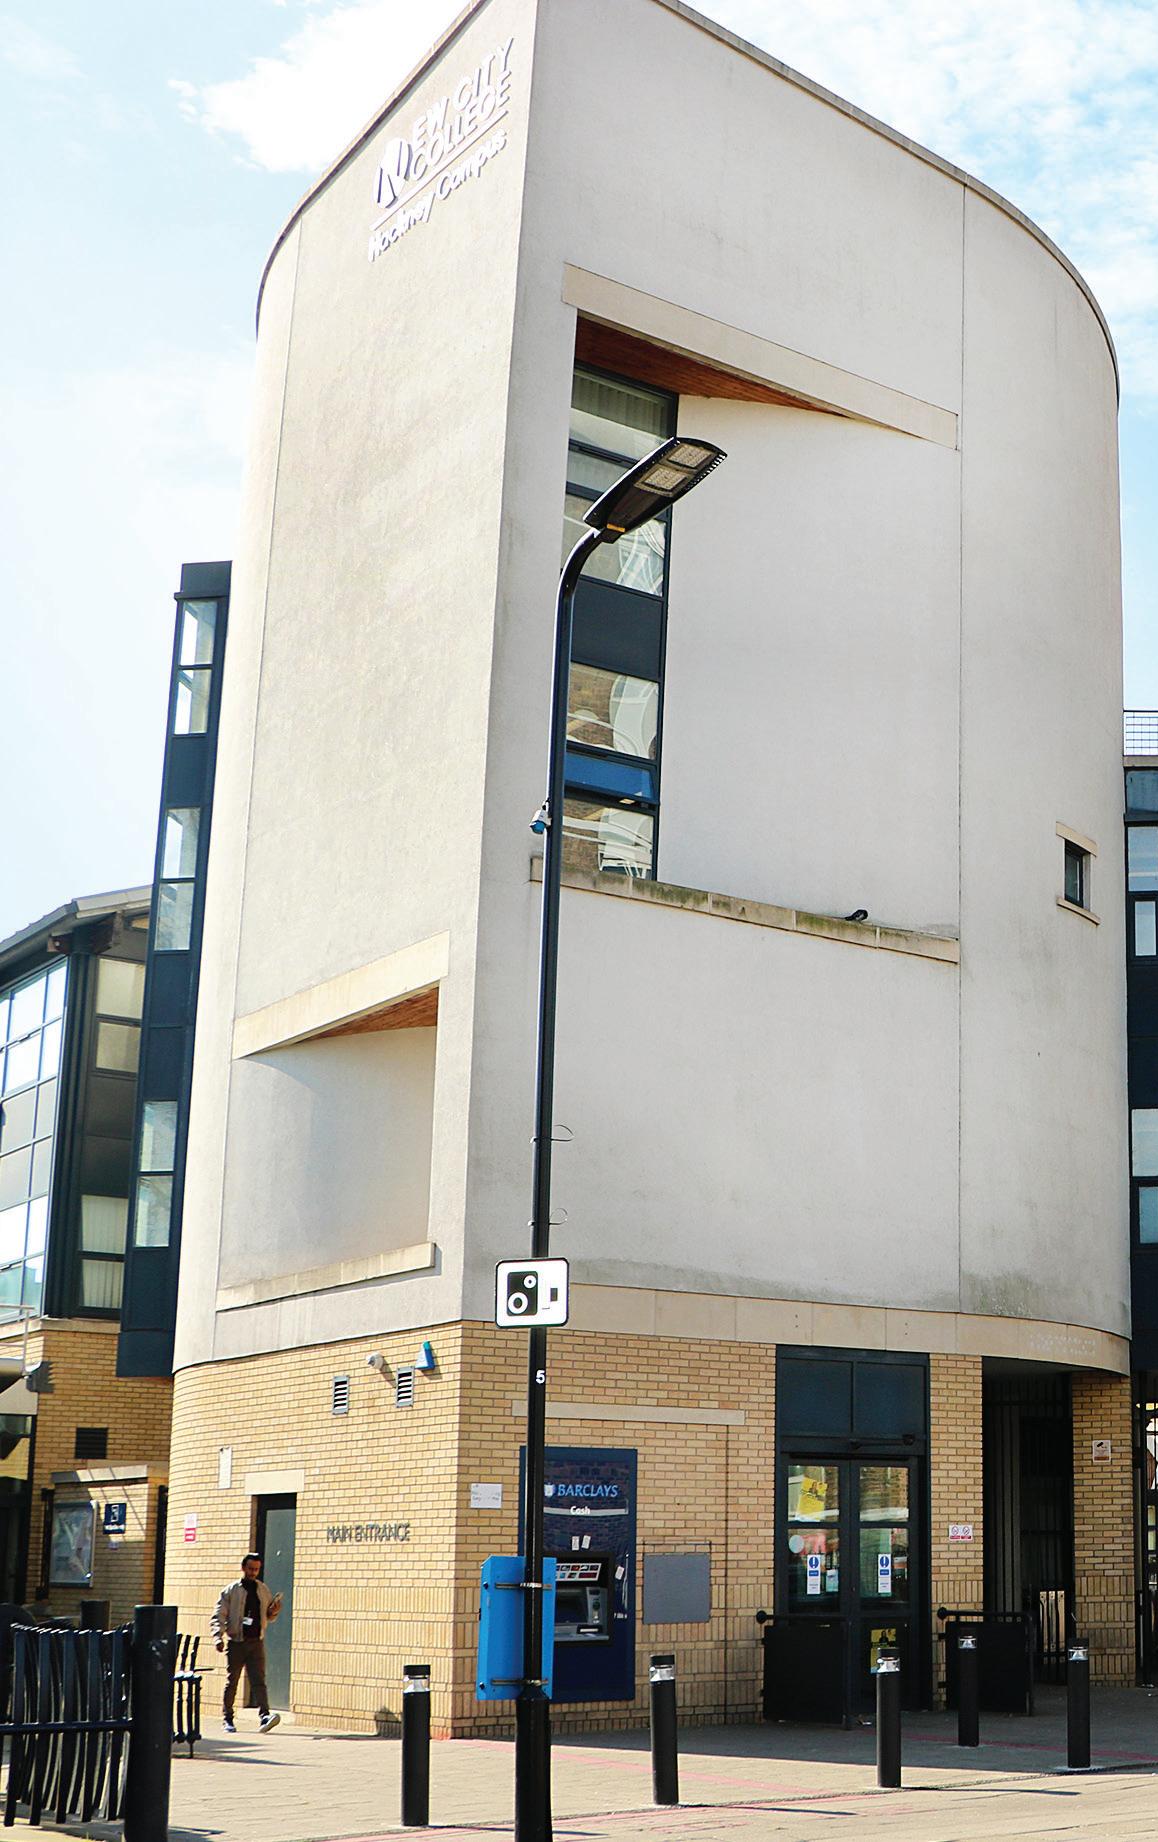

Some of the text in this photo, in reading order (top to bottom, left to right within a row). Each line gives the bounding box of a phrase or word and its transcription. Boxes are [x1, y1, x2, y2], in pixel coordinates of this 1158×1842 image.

[454, 37, 514, 111] CITY
[413, 70, 512, 181] COLLEGE
[368, 127, 508, 263] Hackney Campus
[535, 1369, 546, 1384] 5
[557, 1484, 618, 1498] BARCLAYS
[570, 1505, 591, 1515] Cash
[327, 1521, 410, 1543] MAIN ENTRANCE
